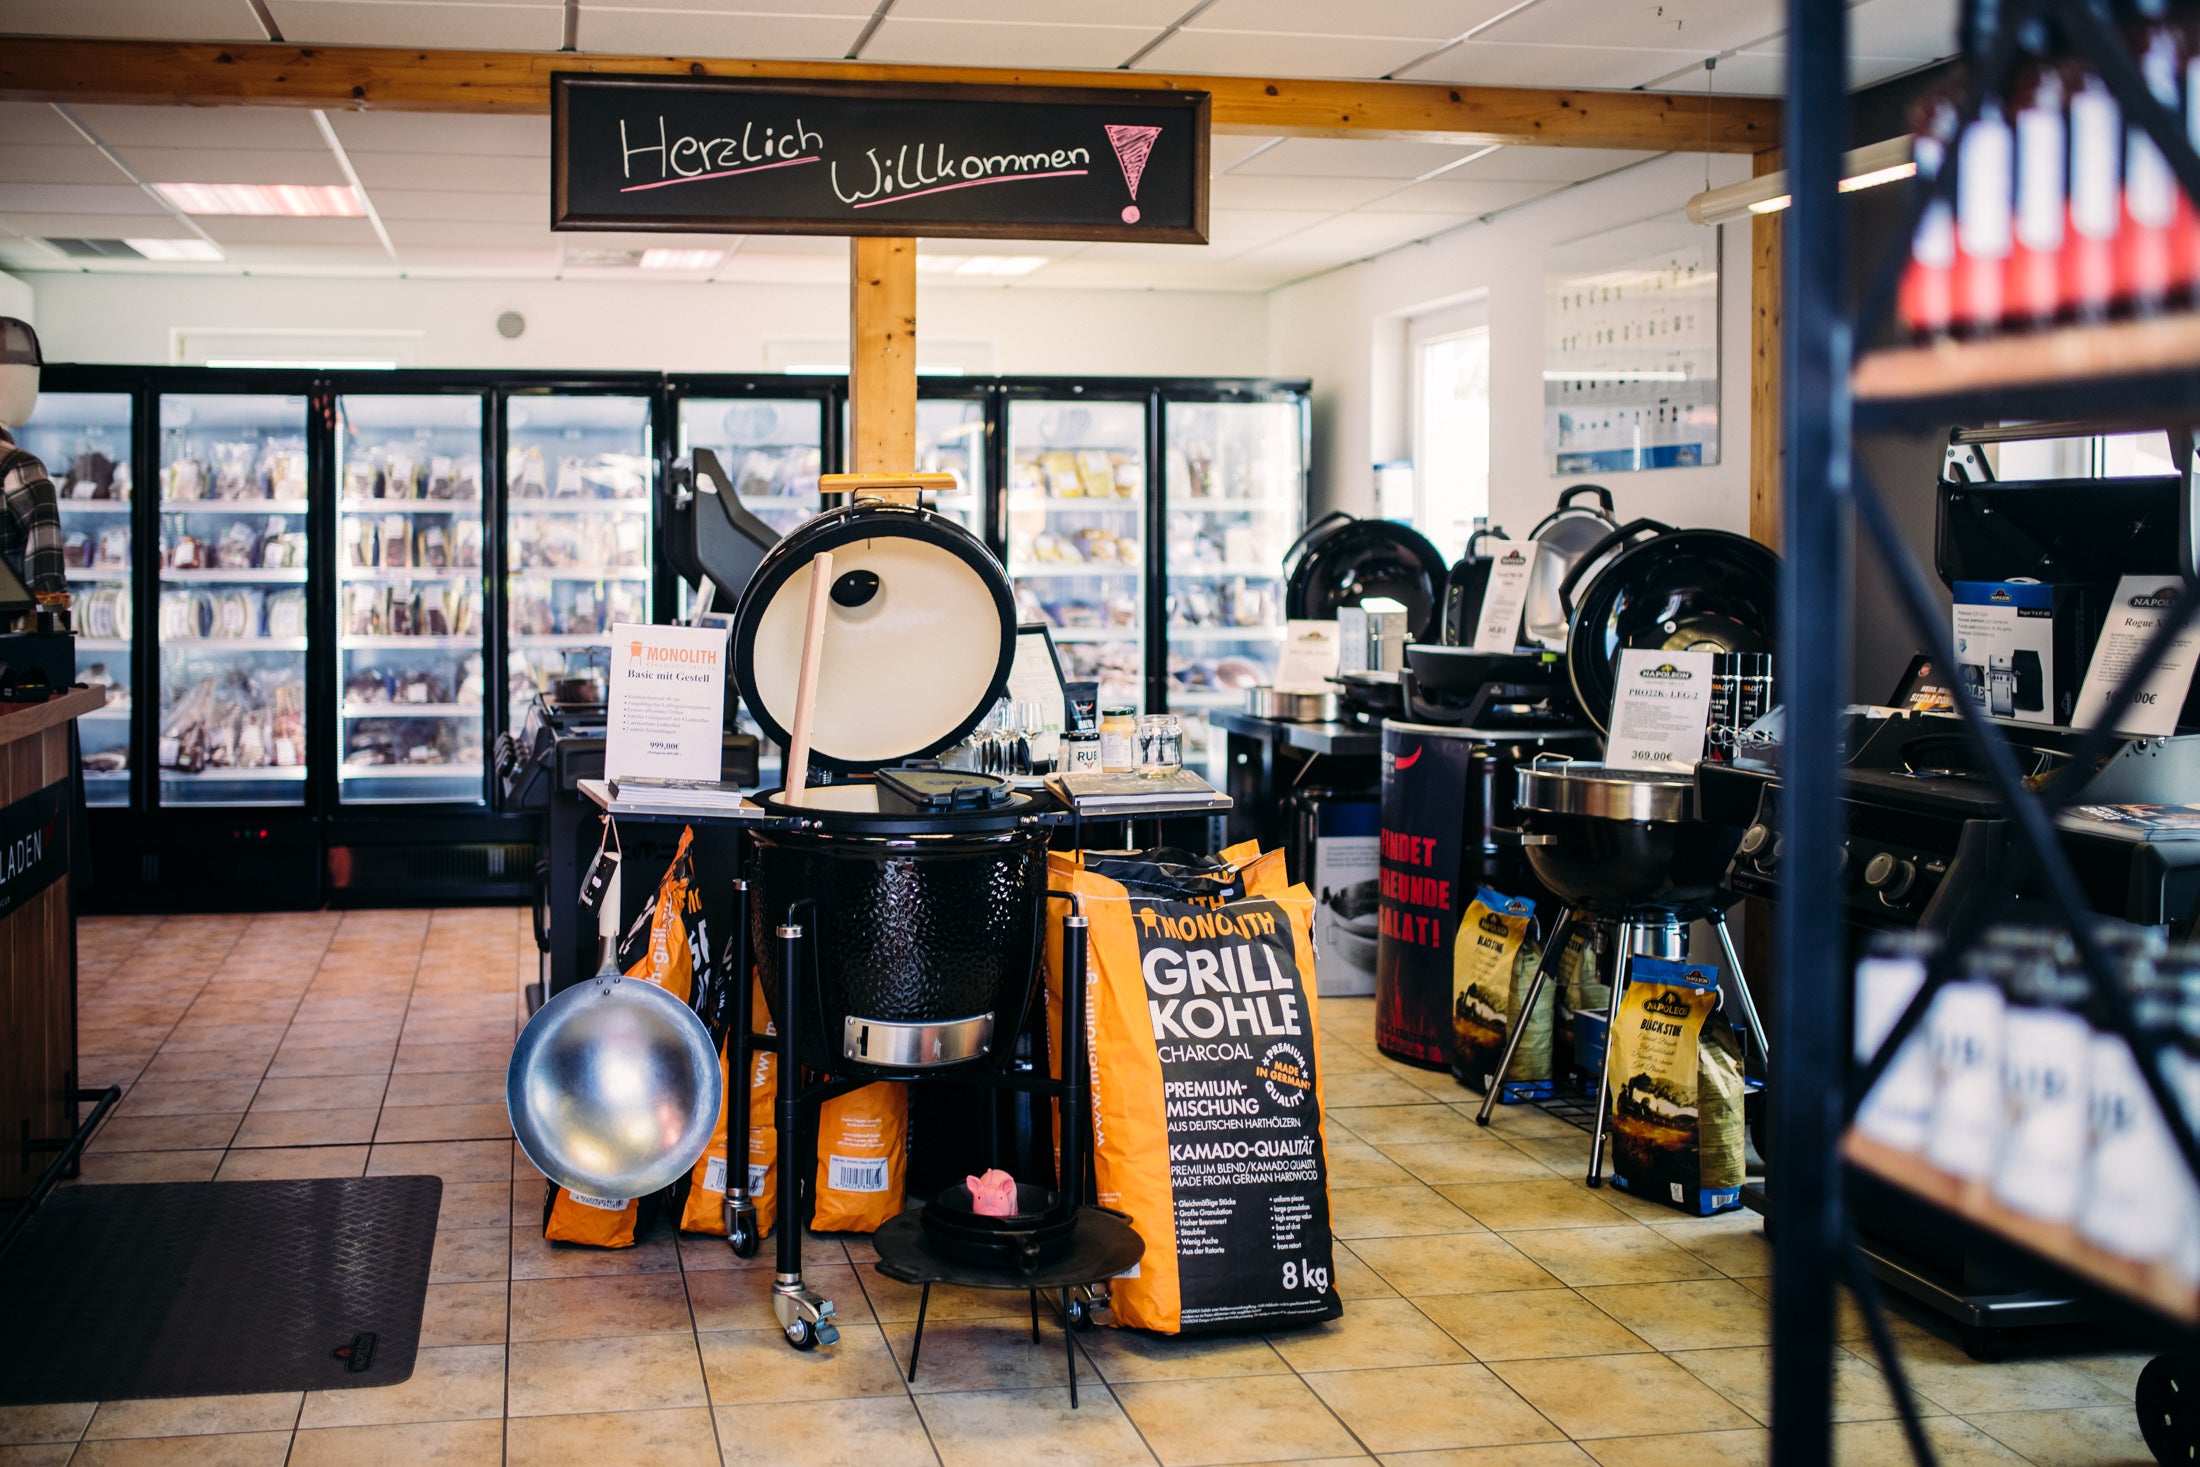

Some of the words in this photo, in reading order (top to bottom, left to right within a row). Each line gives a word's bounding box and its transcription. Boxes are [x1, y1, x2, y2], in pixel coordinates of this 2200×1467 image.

[620, 116, 823, 178] Herzlich
[831, 143, 1090, 203] Willkommen
[2133, 597, 2174, 608] NAPOL
[2125, 617, 2153, 628] Rogue
[647, 647, 717, 665] MONOLITH
[628, 670, 654, 680] Basic
[656, 672, 673, 681] mit
[676, 672, 710, 683] Gestell
[1642, 669, 1690, 680] NAPOLEON
[649, 741, 680, 751] 999,00€
[1142, 944, 1293, 995] GRILL
[1148, 994, 1302, 1040] KOHLE
[1157, 1043, 1254, 1063] CHARCOAL
[1266, 1043, 1306, 1069] PREMIUM
[1274, 1060, 1299, 1076] MADE
[1256, 1066, 1268, 1078] IN
[1270, 1069, 1311, 1091] GERMANY
[1165, 1080, 1248, 1099] PREMIUM-
[1265, 1080, 1305, 1108] QUALITY
[1166, 1098, 1260, 1118] MISCHUNG
[1168, 1121, 1188, 1133] AUS
[1190, 1118, 1244, 1131] DEUTSCHEN
[1245, 1116, 1301, 1129] HARTHÖLZERN
[1170, 1135, 1315, 1161] KAMADO-QUALITÄT
[1170, 1163, 1216, 1176] PREMIUM
[1217, 1160, 1290, 1177] BLEND/KAMADO
[1290, 1159, 1316, 1170] QUALITY
[1172, 1176, 1202, 1188] MADE
[1203, 1174, 1231, 1186] FROM
[1231, 1172, 1273, 1184] GERMAN
[1274, 1170, 1318, 1181] HARDWOOD
[1179, 1209, 1199, 1217] Große
[1199, 1208, 1233, 1216] Granulation
[1179, 1219, 1198, 1227] Hoher
[1181, 1238, 1200, 1247] Wenig
[1201, 1237, 1219, 1245] Asche
[1182, 1247, 1194, 1255] Aus
[1194, 1247, 1204, 1255] der
[1282, 1261, 1299, 1290] 8
[1302, 1258, 1329, 1294] kg
